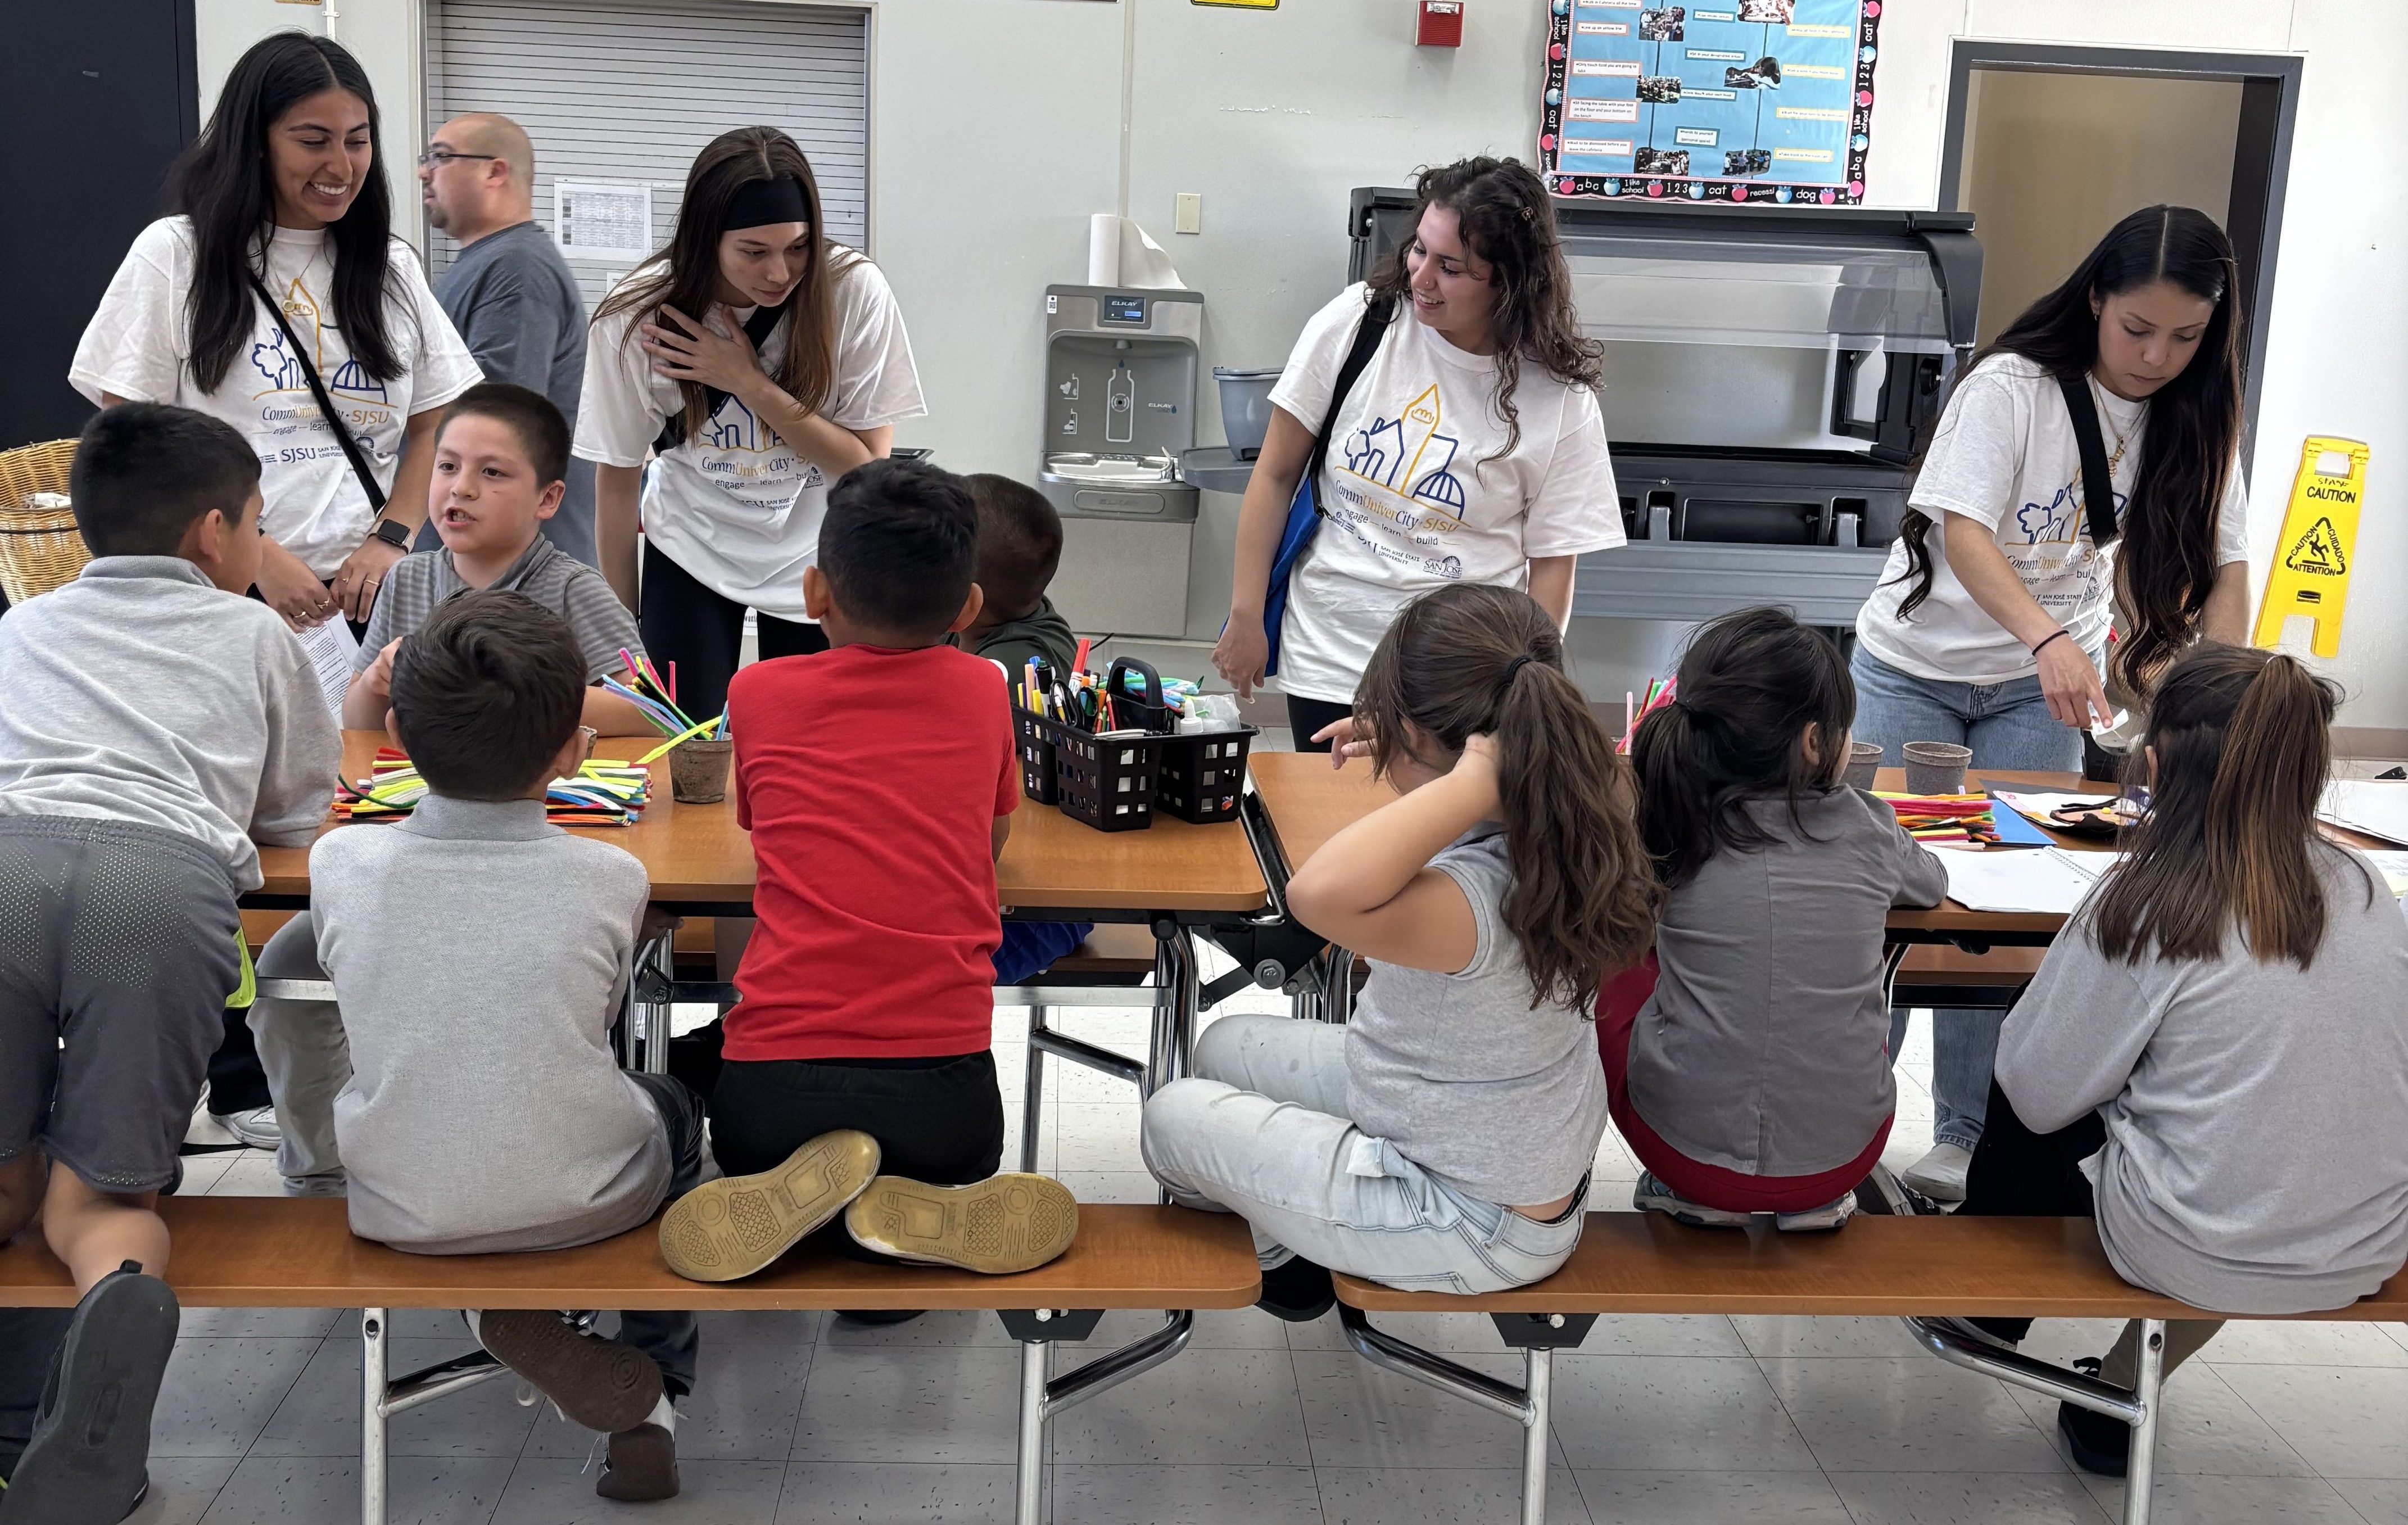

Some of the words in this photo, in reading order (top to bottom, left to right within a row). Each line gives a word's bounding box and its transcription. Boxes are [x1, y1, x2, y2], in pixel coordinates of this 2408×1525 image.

[1863, 22, 1873, 42] cat
[1709, 185, 1727, 195] cat
[1796, 189, 1816, 202] dog
[351, 410, 390, 426] SJSU
[281, 448, 316, 464] SJSU
[716, 479, 745, 490] engage
[2307, 486, 2356, 504] CAUTION
[1336, 480, 1419, 531] CommUniverCity
[1423, 518, 1460, 532] SJSU
[1346, 509, 1369, 523] ngage
[1416, 536, 1438, 546] build
[2291, 526, 2318, 556] CAUTION
[2327, 528, 2345, 563] CUIDADO
[1425, 560, 1442, 571] SAN
[2293, 563, 2336, 577] ATTENTION
